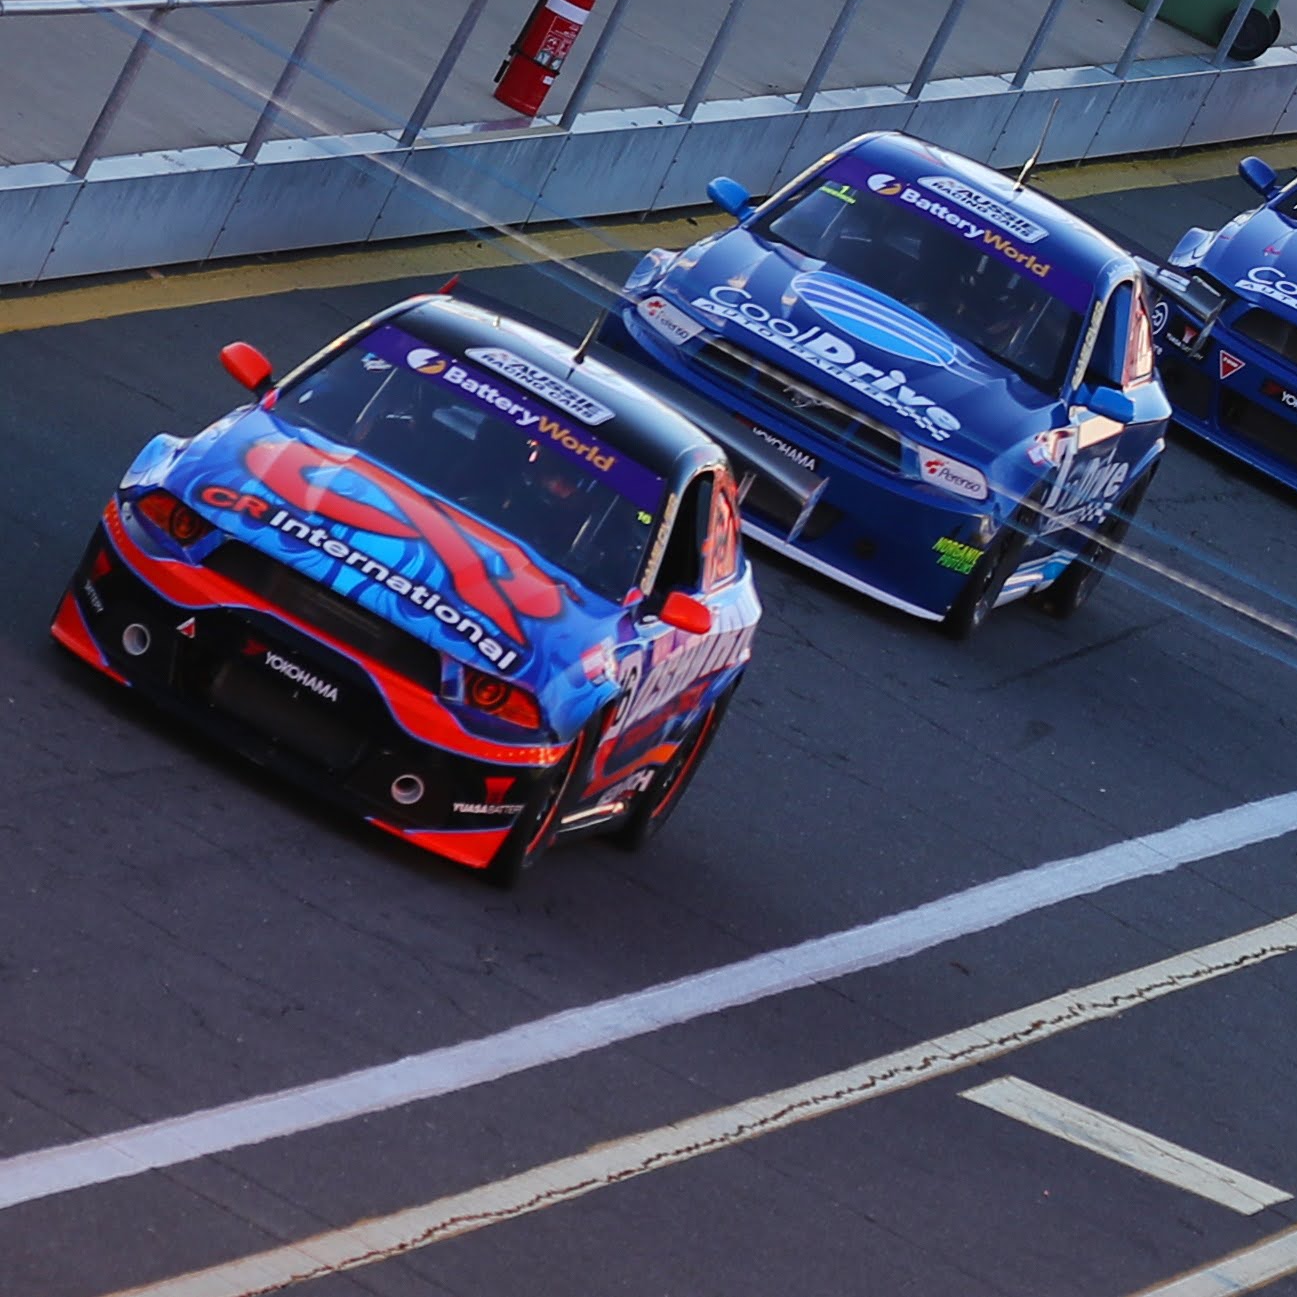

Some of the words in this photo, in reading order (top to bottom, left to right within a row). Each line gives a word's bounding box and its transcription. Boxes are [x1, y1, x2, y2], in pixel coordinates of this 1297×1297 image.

[930, 181, 991, 214] RACING
[952, 187, 1041, 234] AUSSIE
[709, 285, 962, 432] CoolDrive
[482, 354, 545, 395] RACING
[545, 392, 595, 419] CARS
[507, 359, 602, 415] AUSSIE
[752, 426, 816, 472] YOKOHAMA
[201, 484, 267, 518] CR
[270, 507, 518, 671] International
[264, 650, 340, 702] YOKOHAMA
